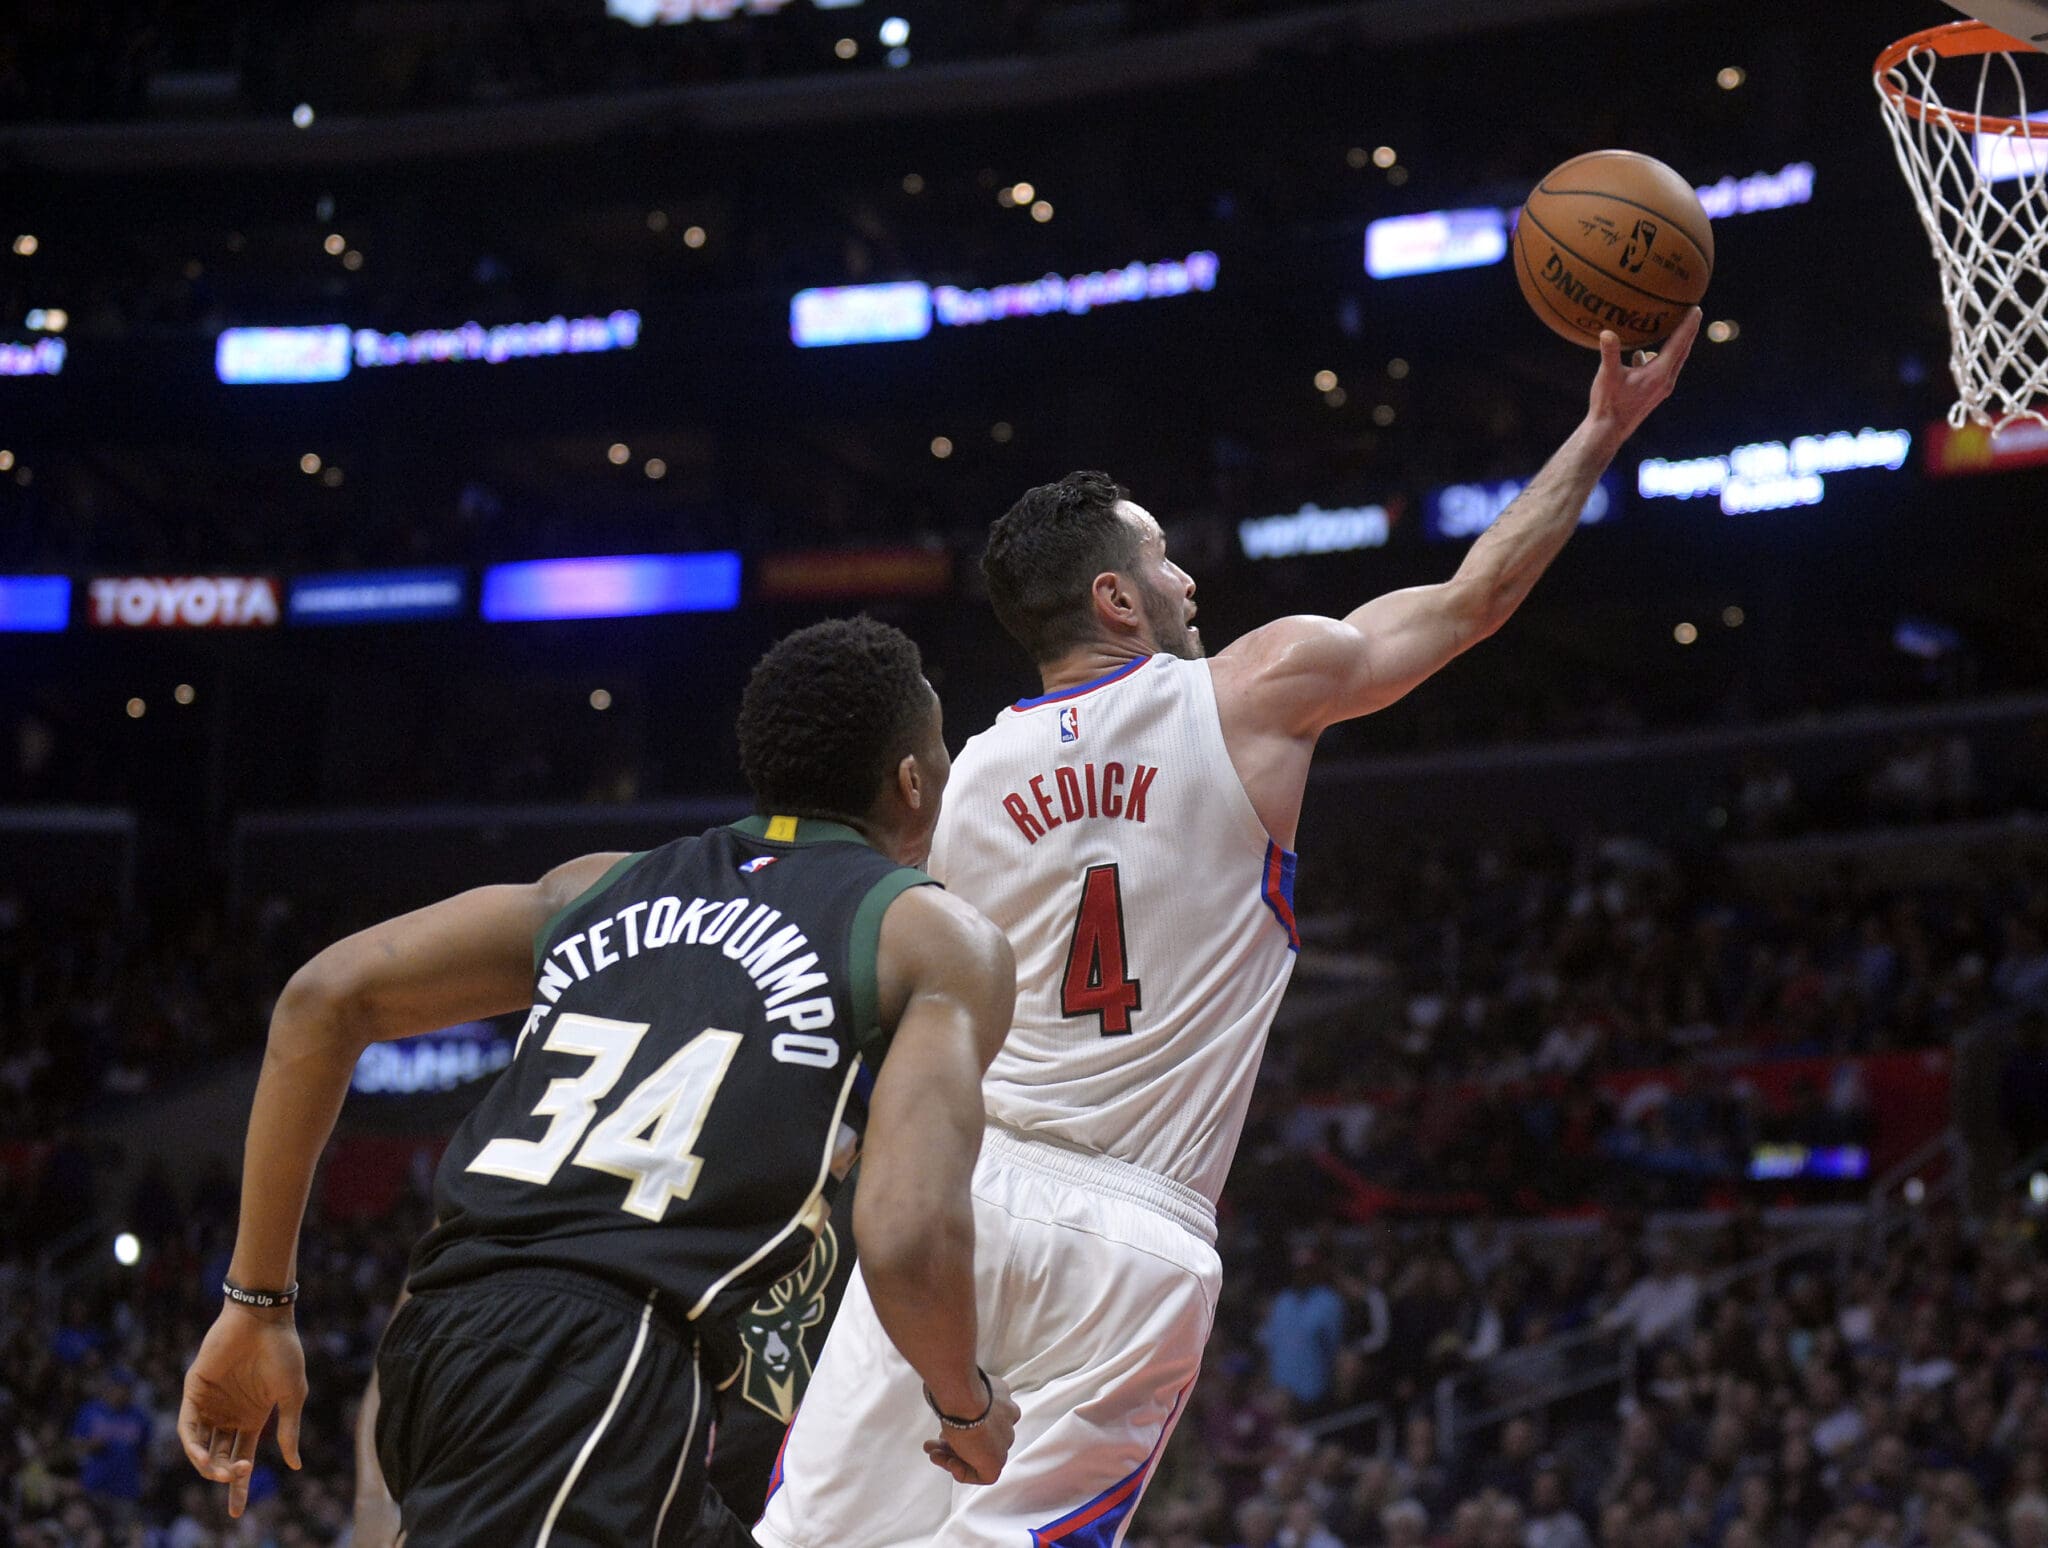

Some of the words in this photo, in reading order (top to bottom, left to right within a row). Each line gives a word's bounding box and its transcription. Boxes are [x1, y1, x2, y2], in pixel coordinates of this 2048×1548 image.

[1541, 251, 1669, 333] SPALDING
[92, 576, 278, 625] TOYOTA
[1002, 762, 1158, 845] REDICK
[1061, 863, 1142, 1037] 4
[465, 1013, 743, 1222] 34
[232, 1289, 255, 1303] Give
[257, 1295, 273, 1307] Up
